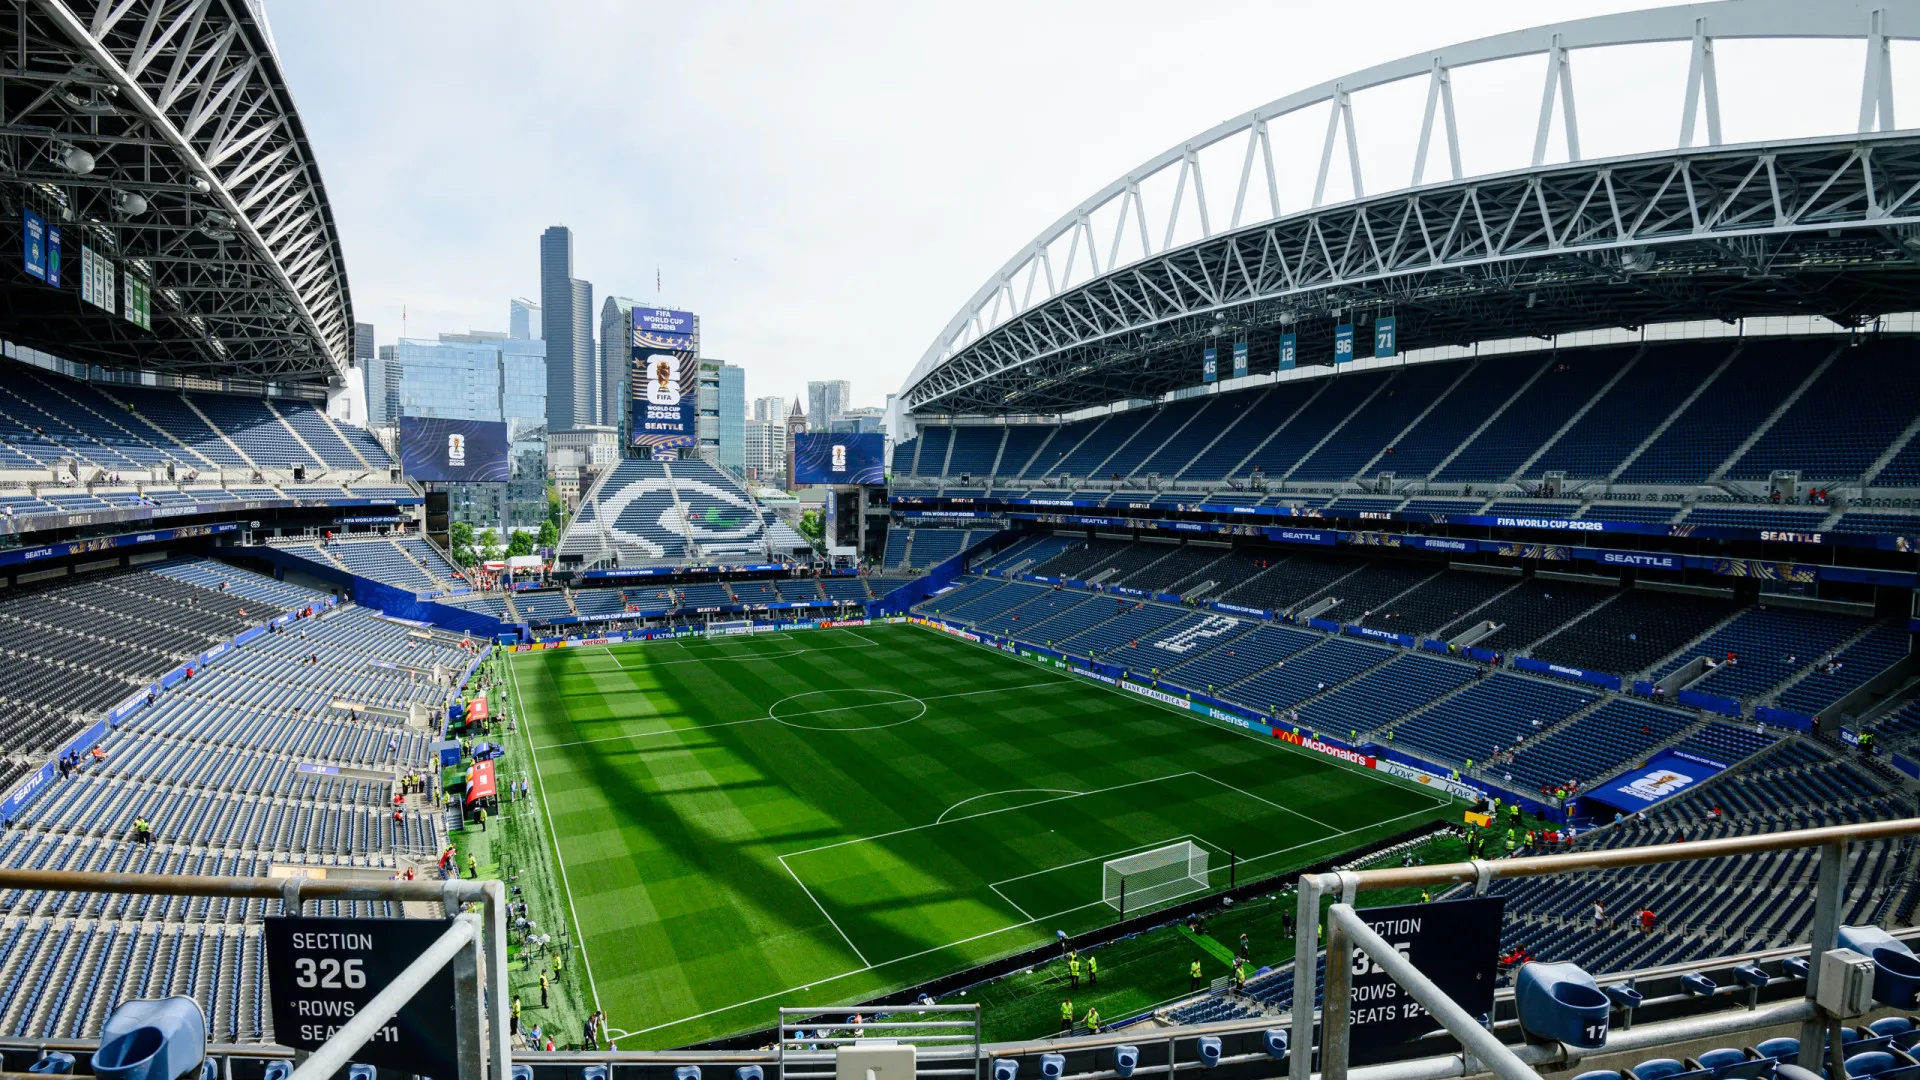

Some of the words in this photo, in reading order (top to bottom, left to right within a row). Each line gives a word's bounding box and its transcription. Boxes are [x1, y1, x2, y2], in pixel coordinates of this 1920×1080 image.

[644, 316, 669, 324] WORLD
[651, 322, 676, 330] 2026
[1336, 338, 1351, 354] 96
[1378, 333, 1392, 348] 71
[1282, 348, 1293, 362] 12
[1204, 361, 1216, 374] 45
[1235, 356, 1246, 370] 80
[647, 411, 680, 420] 2026
[645, 422, 684, 430] SEATTLE
[68, 514, 92, 524] SEATTLE
[1498, 518, 1516, 526] FIFA
[1516, 518, 1548, 528] WORLD
[1550, 520, 1568, 528] CUP
[1569, 522, 1602, 530] 2026
[1282, 532, 1320, 540] SEATTLE
[1760, 531, 1822, 544] SEATTLE
[25, 548, 52, 559] SEATTLE
[1604, 554, 1672, 566] SEATTLE
[1362, 628, 1398, 640] SEATTLE
[207, 644, 225, 658] SEATTLE
[1124, 682, 1140, 692] BANK
[1150, 691, 1180, 705] AMERICA
[1210, 708, 1250, 728] Hisense
[1842, 732, 1878, 754] SEAE
[1302, 737, 1366, 766] McDonald's
[14, 770, 44, 804] SEATTLE
[1364, 918, 1421, 936] CTION
[292, 932, 372, 950] SECTION
[295, 958, 366, 988] 326
[1350, 983, 1396, 1002] ROWS
[298, 1000, 355, 1016] ROWS
[1350, 1006, 1396, 1025] SEATS
[1586, 1024, 1606, 1038] 17
